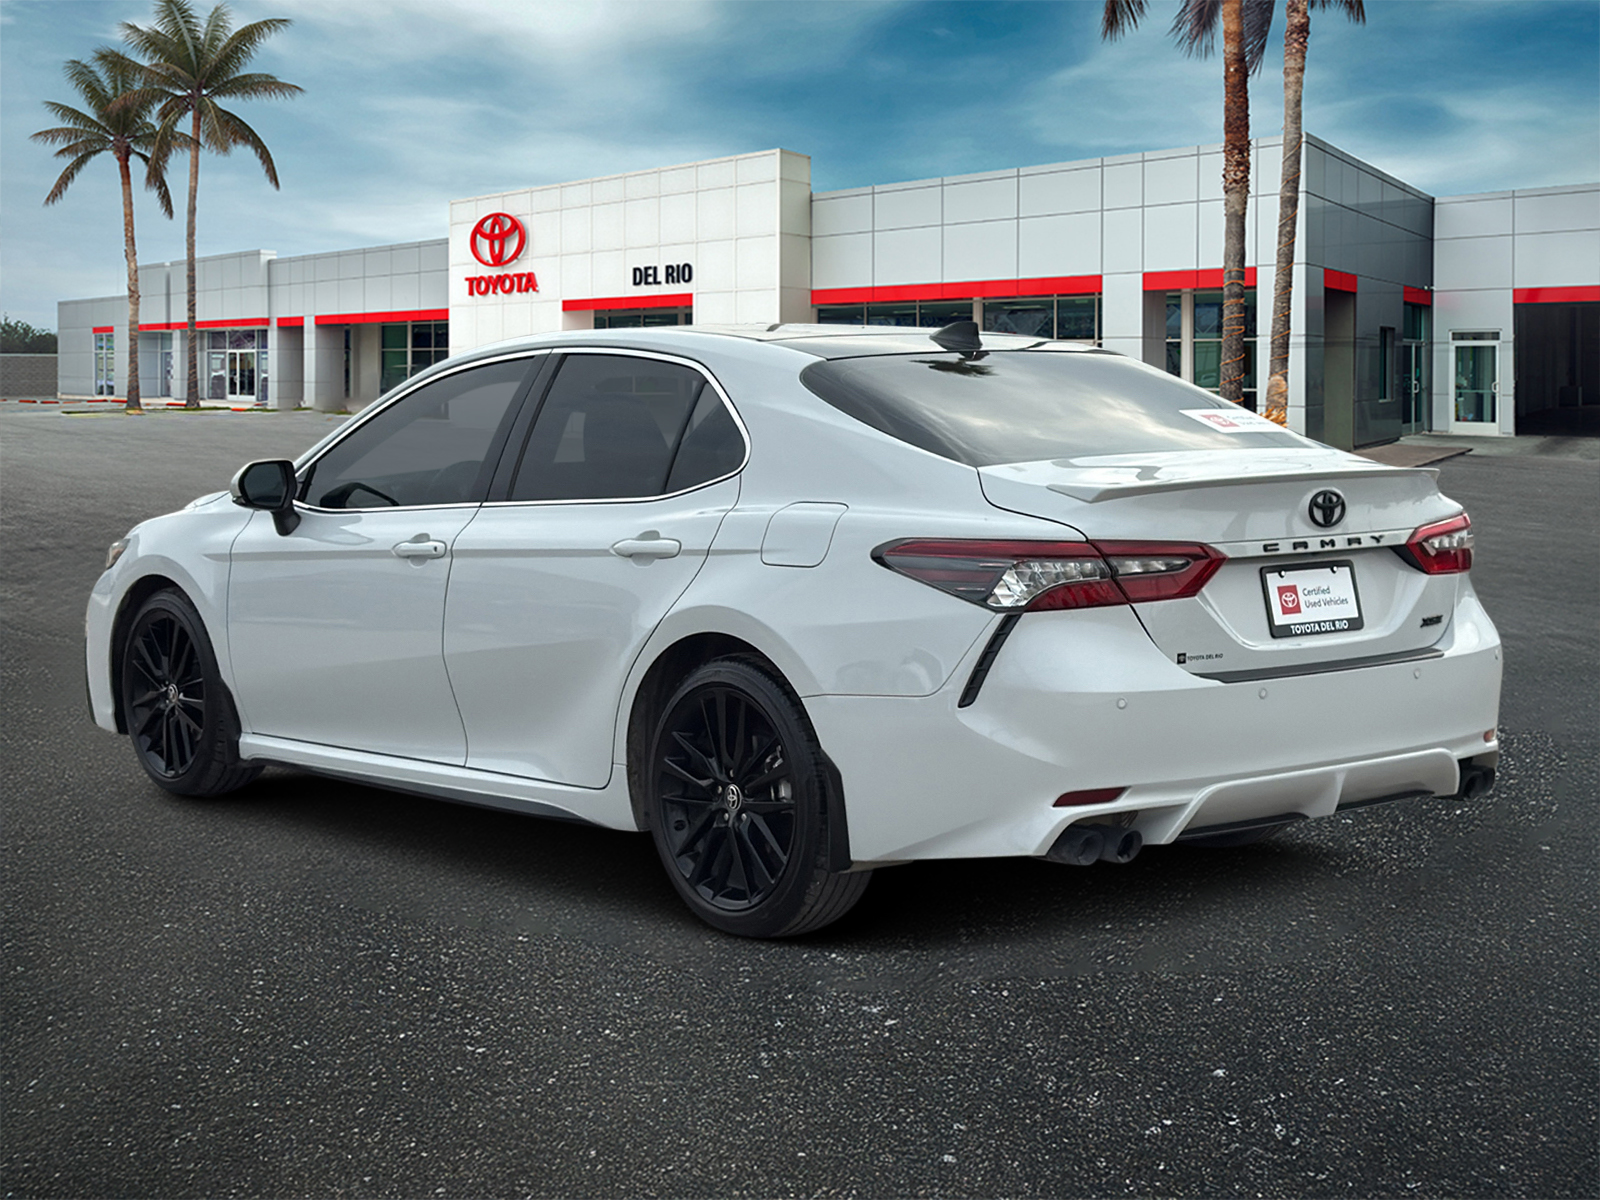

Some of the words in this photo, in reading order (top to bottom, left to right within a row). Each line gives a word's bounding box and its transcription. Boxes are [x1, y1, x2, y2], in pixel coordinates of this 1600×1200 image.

[632, 265, 661, 286] DEL
[665, 263, 693, 284] RIO
[465, 272, 539, 296] TOYOTA
[1262, 534, 1385, 552] CAMRY
[1302, 586, 1331, 597] Certified
[1304, 599, 1322, 608] Used
[1323, 597, 1349, 607] Vehicles
[1290, 623, 1320, 634] TOYOTA
[1320, 621, 1335, 632] DEL
[1335, 620, 1349, 630] RIO
